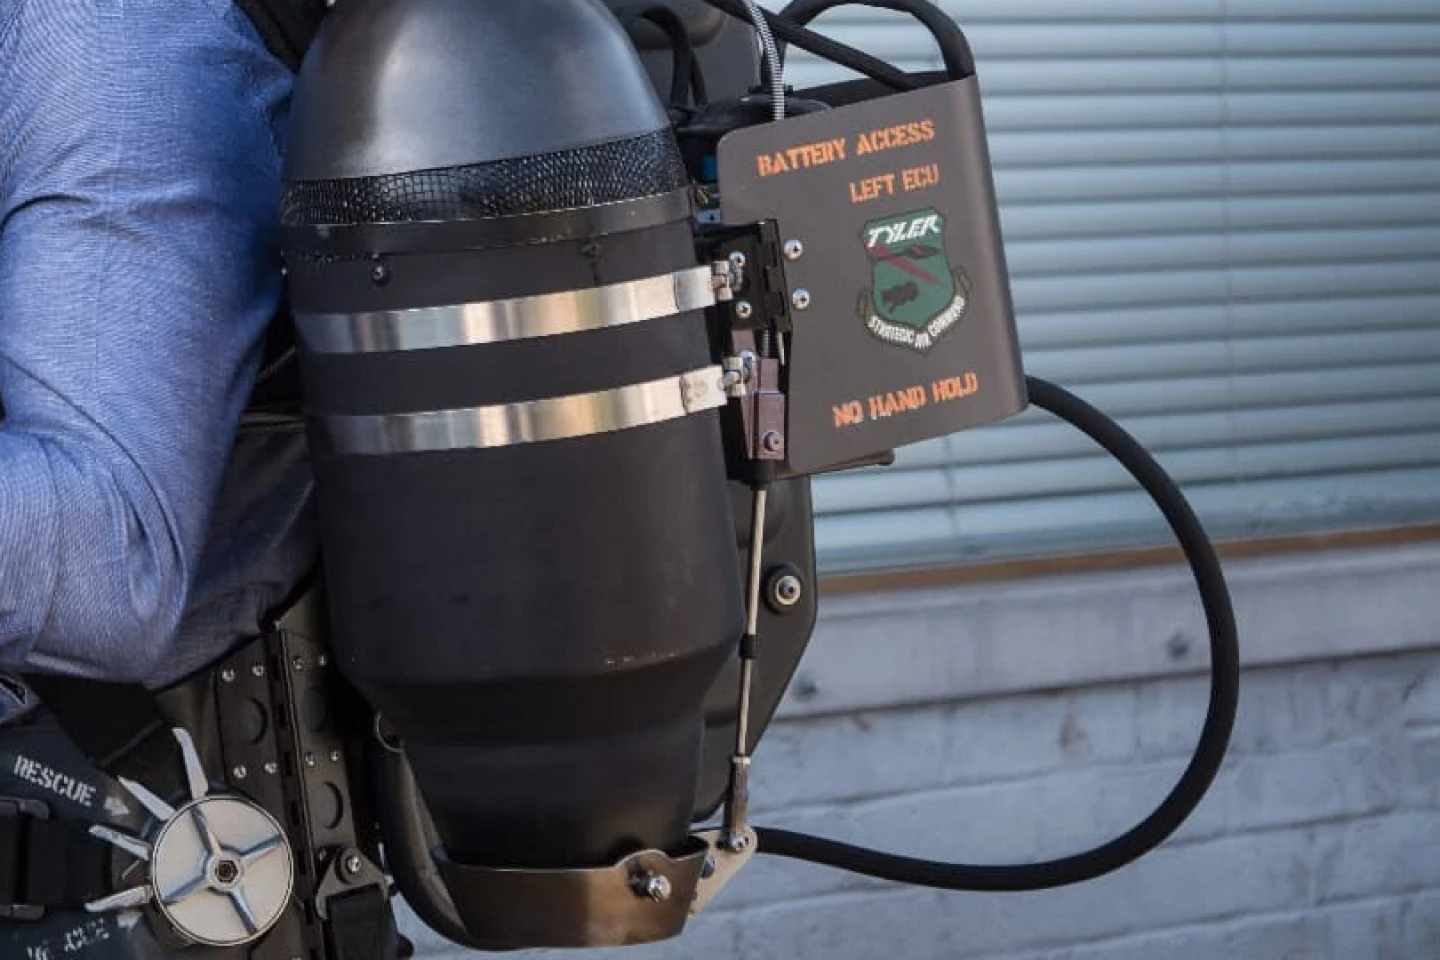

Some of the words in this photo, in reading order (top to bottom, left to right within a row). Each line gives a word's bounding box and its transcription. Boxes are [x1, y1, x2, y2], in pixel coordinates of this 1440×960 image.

[757, 137, 846, 177] BATTERY
[856, 120, 936, 156] ACCESS
[849, 173, 895, 204] LEFT
[901, 163, 940, 192] ECU
[867, 214, 941, 248] TYLER
[832, 399, 864, 427] NO
[868, 384, 927, 420] HAND
[932, 371, 979, 404] HOLD
[13, 754, 97, 807] RESCUE
